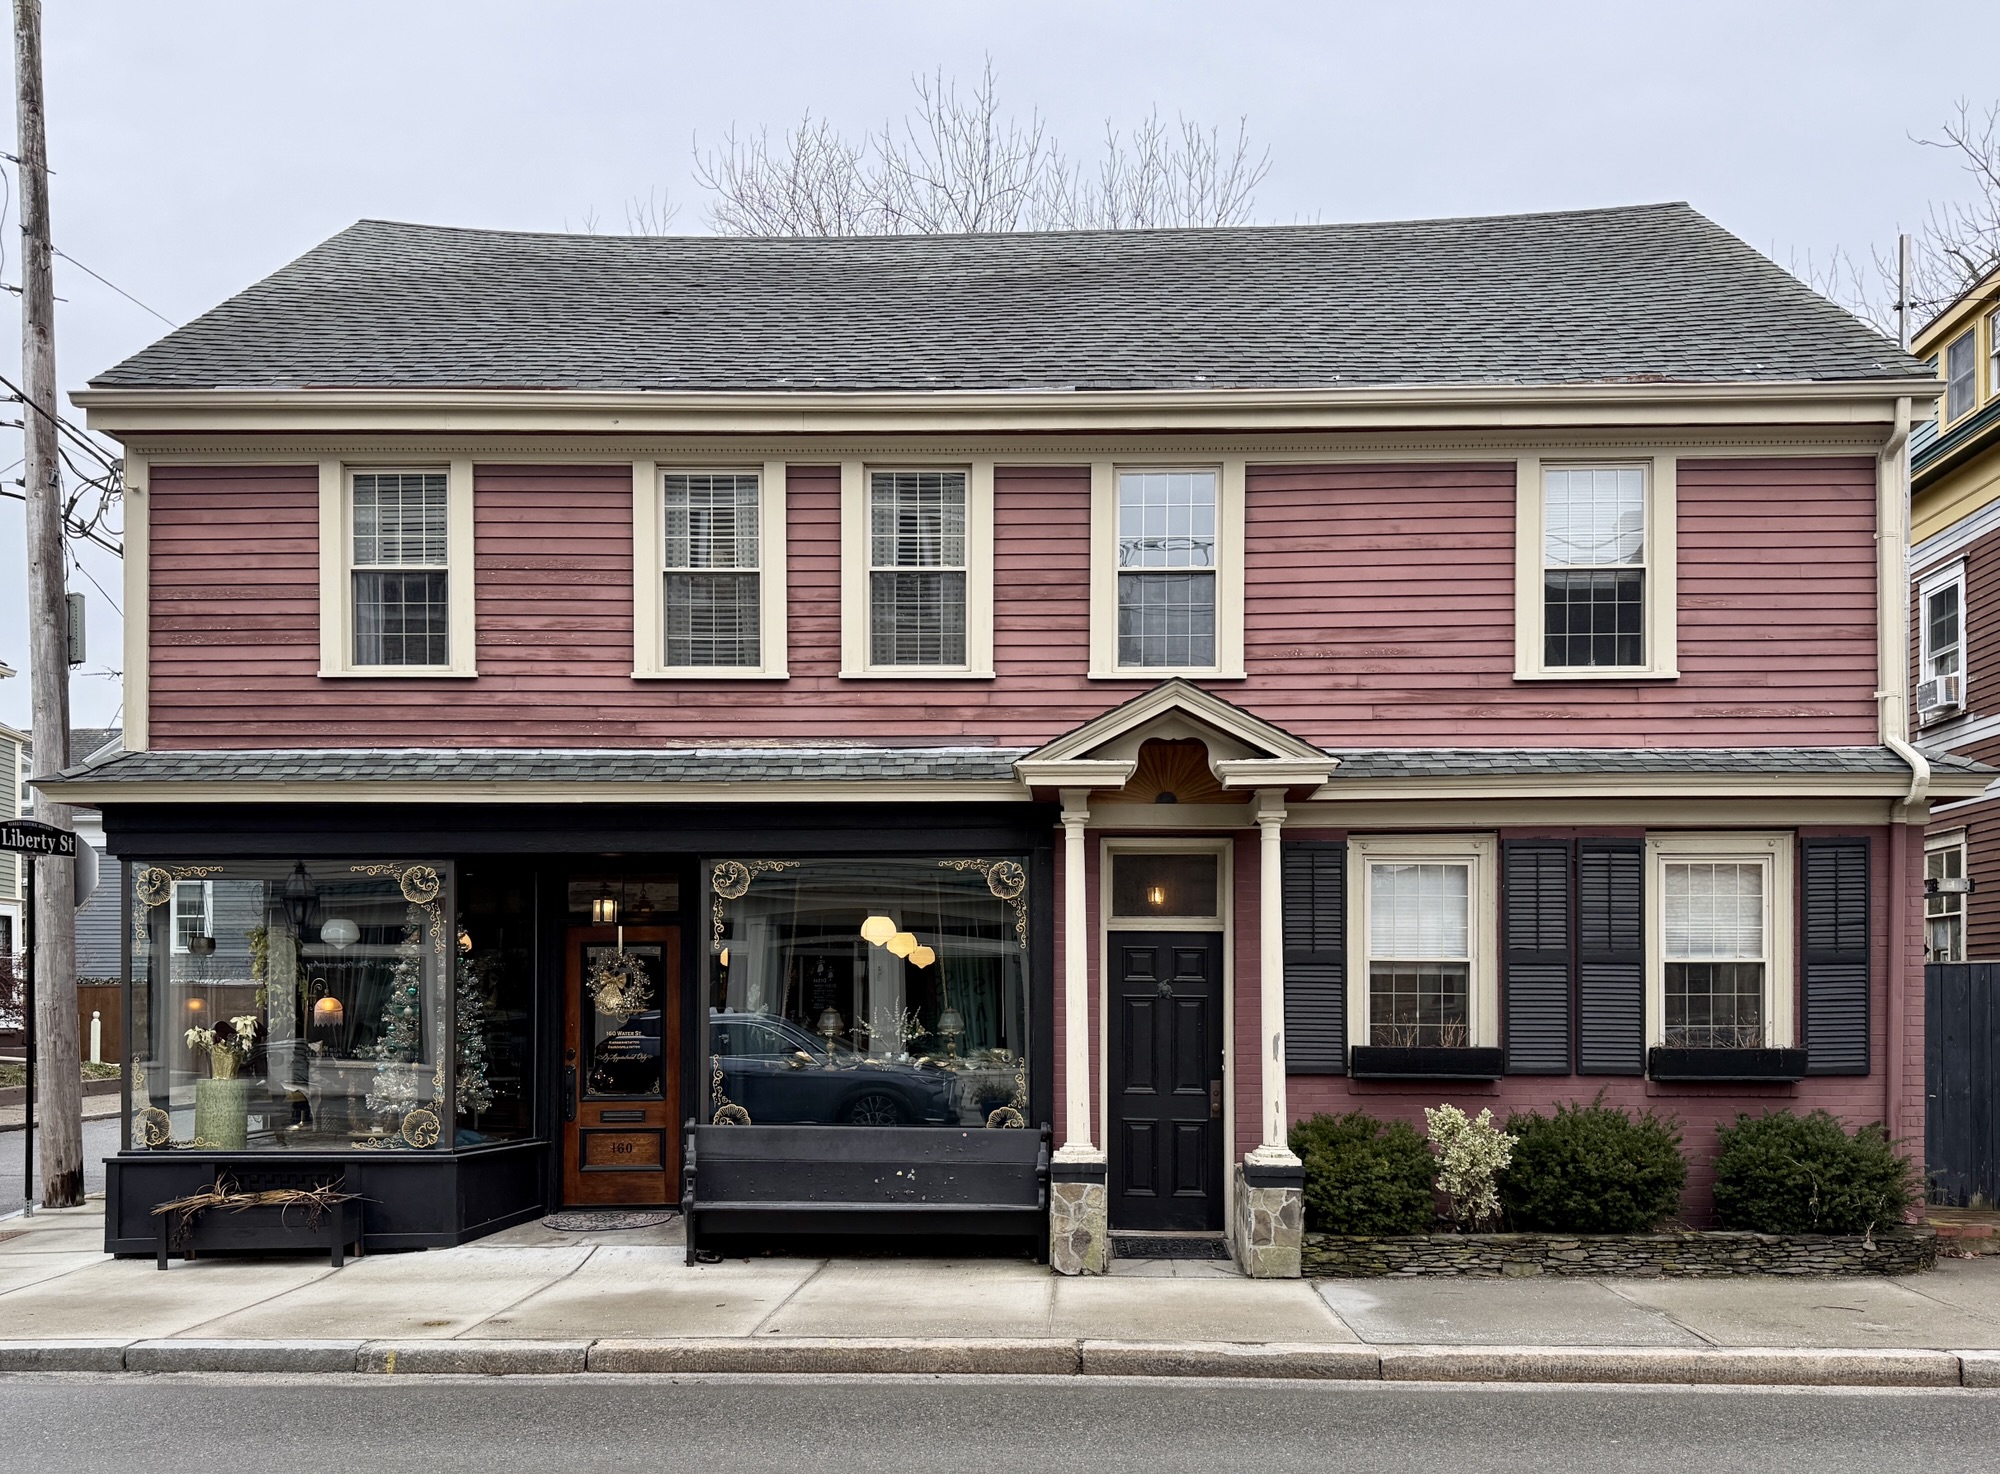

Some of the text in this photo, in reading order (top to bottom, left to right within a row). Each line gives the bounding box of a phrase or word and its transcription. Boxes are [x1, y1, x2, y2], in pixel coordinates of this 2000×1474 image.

[1, 828, 74, 854] Liberty St
[612, 1142, 633, 1154] 160
